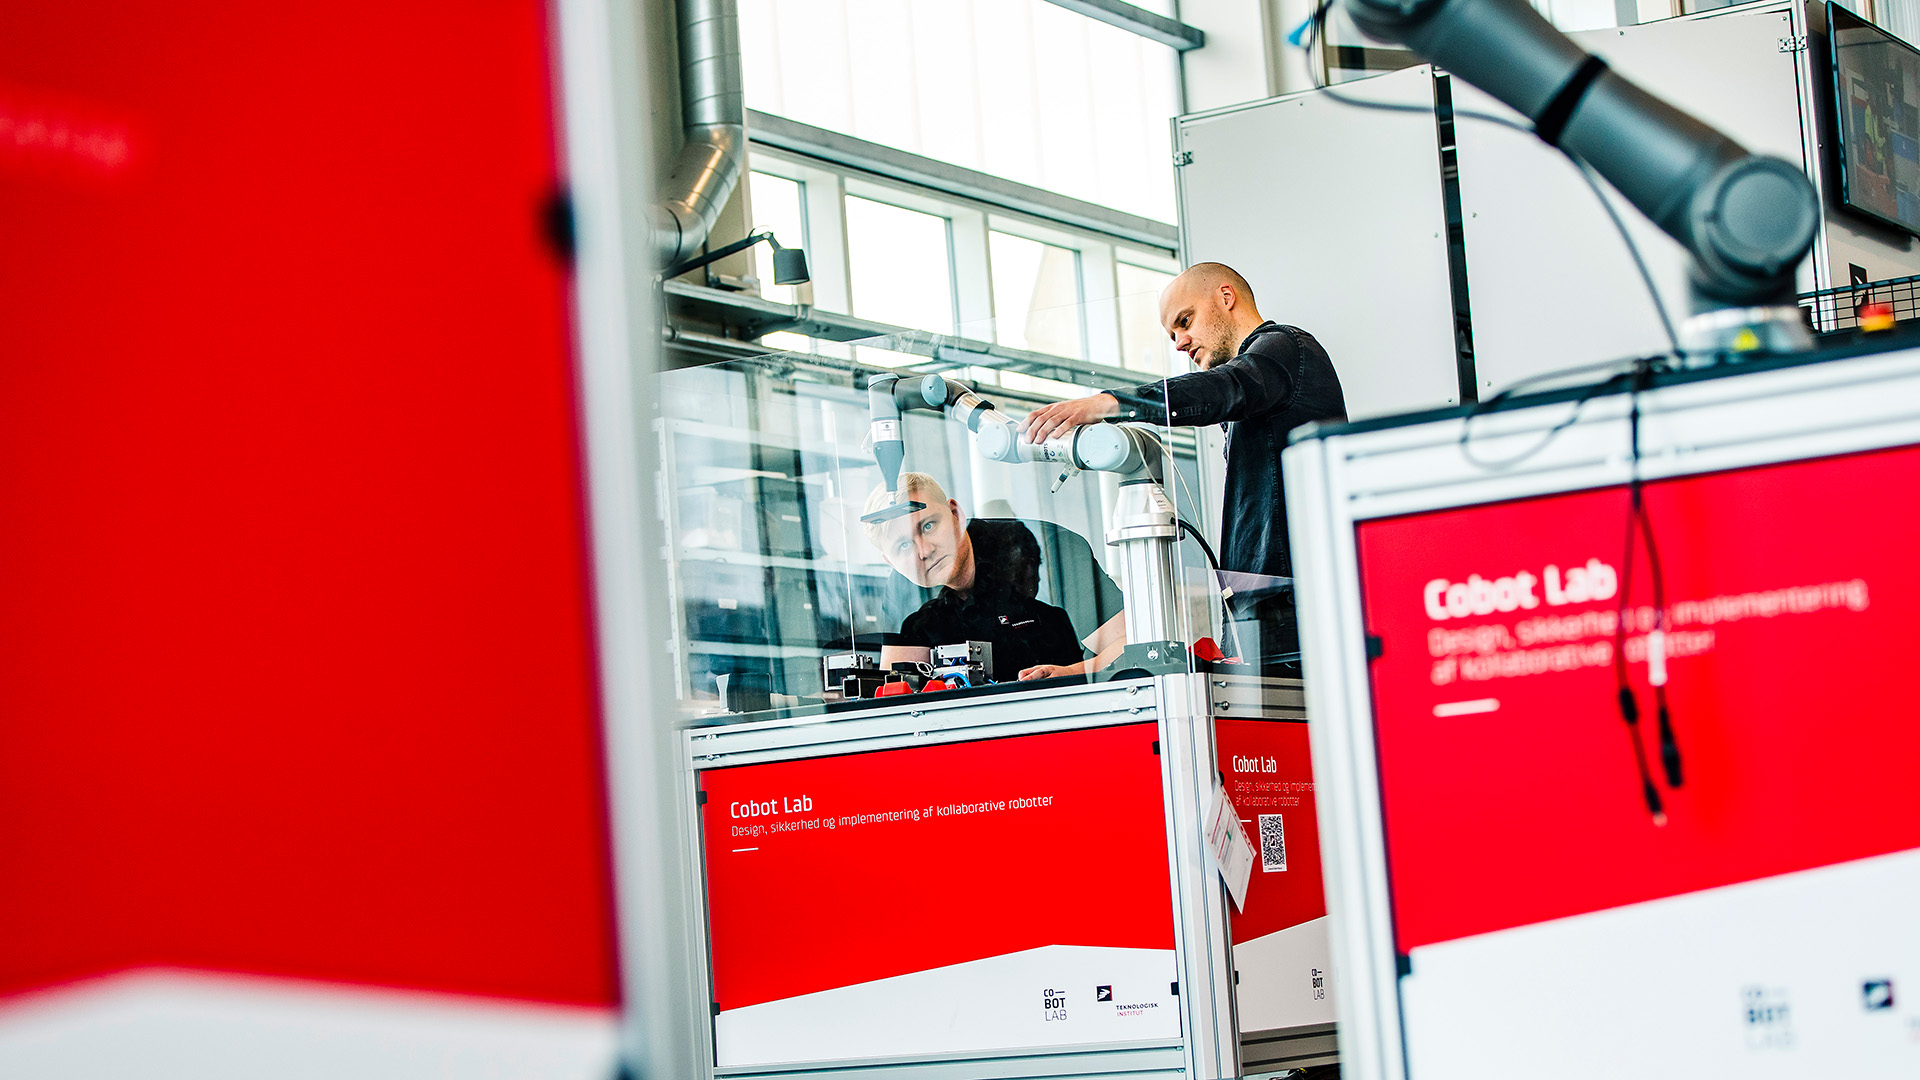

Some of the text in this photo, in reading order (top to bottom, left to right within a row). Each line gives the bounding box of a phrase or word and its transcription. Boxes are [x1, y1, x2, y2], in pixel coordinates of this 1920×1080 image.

[1424, 558, 1618, 620] Cobot Lab
[1233, 755, 1277, 773] Cobot Lab
[730, 794, 813, 819] Cobot Lab
[731, 796, 1053, 837] Design, sikkerhed og implementering af kollaborative robotter
[1313, 989, 1325, 1000] LAB
[1044, 998, 1066, 1009] BOT
[1116, 1002, 1159, 1011] TEKNOLOGISK
[1045, 1009, 1067, 1021] LAB
